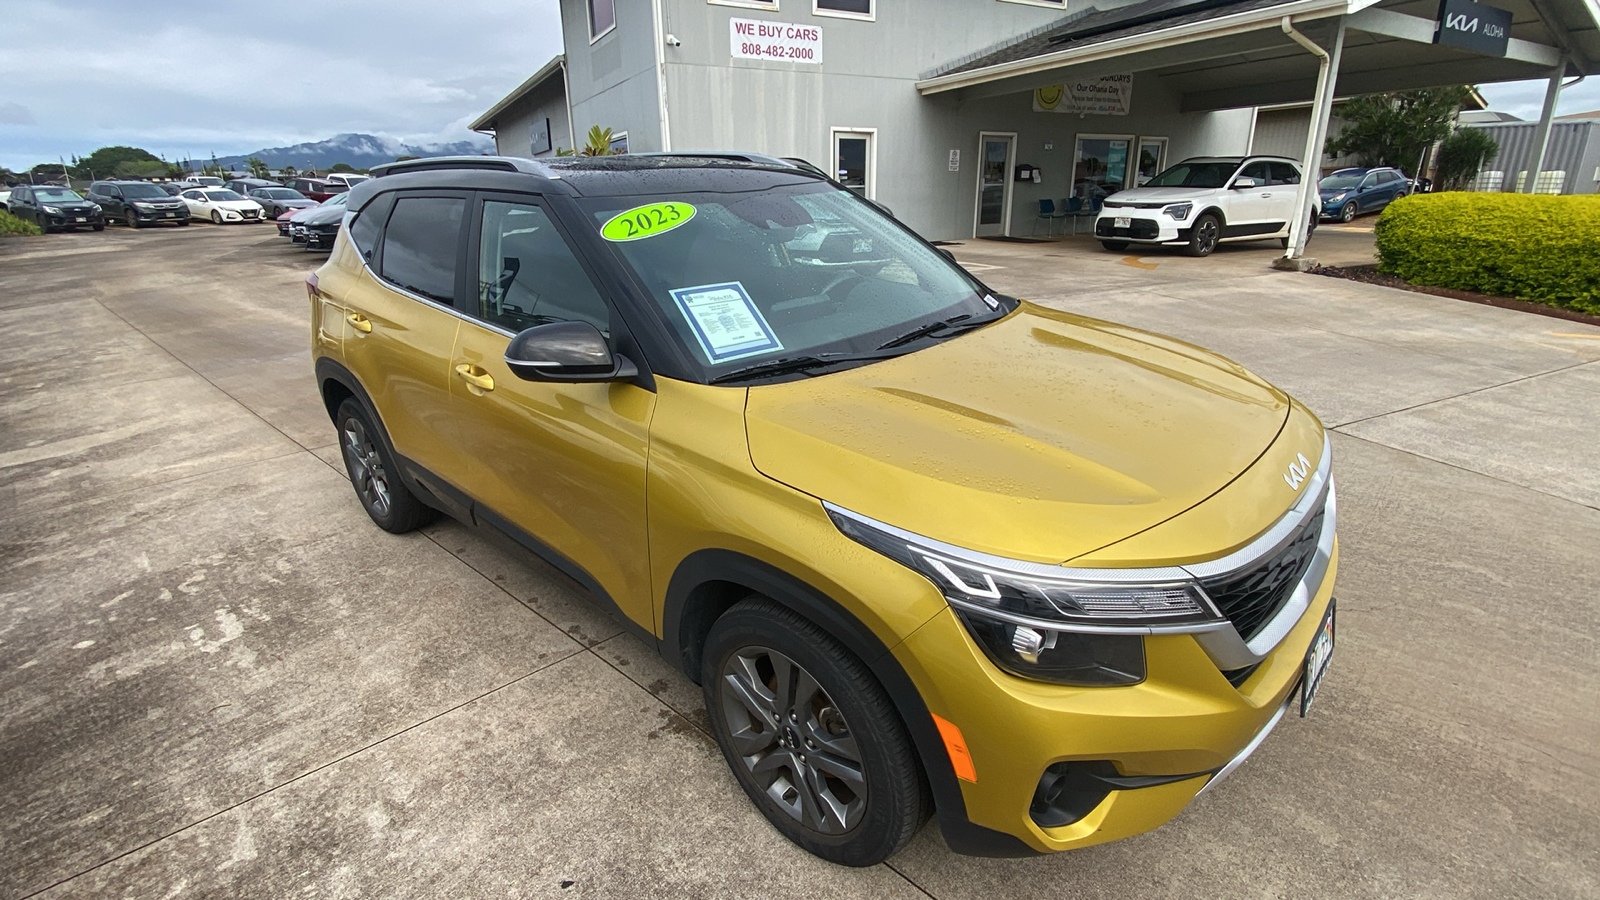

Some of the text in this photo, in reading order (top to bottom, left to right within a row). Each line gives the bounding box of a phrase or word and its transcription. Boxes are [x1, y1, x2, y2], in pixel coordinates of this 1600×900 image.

[735, 22, 818, 41] WE BUY CARS
[1446, 12, 1504, 38] KIA ALOHA
[741, 42, 814, 59] 808-482-2000
[1076, 83, 1119, 95] Our Ohana Day
[620, 204, 681, 237] 2023
[1281, 452, 1311, 492] KIA
